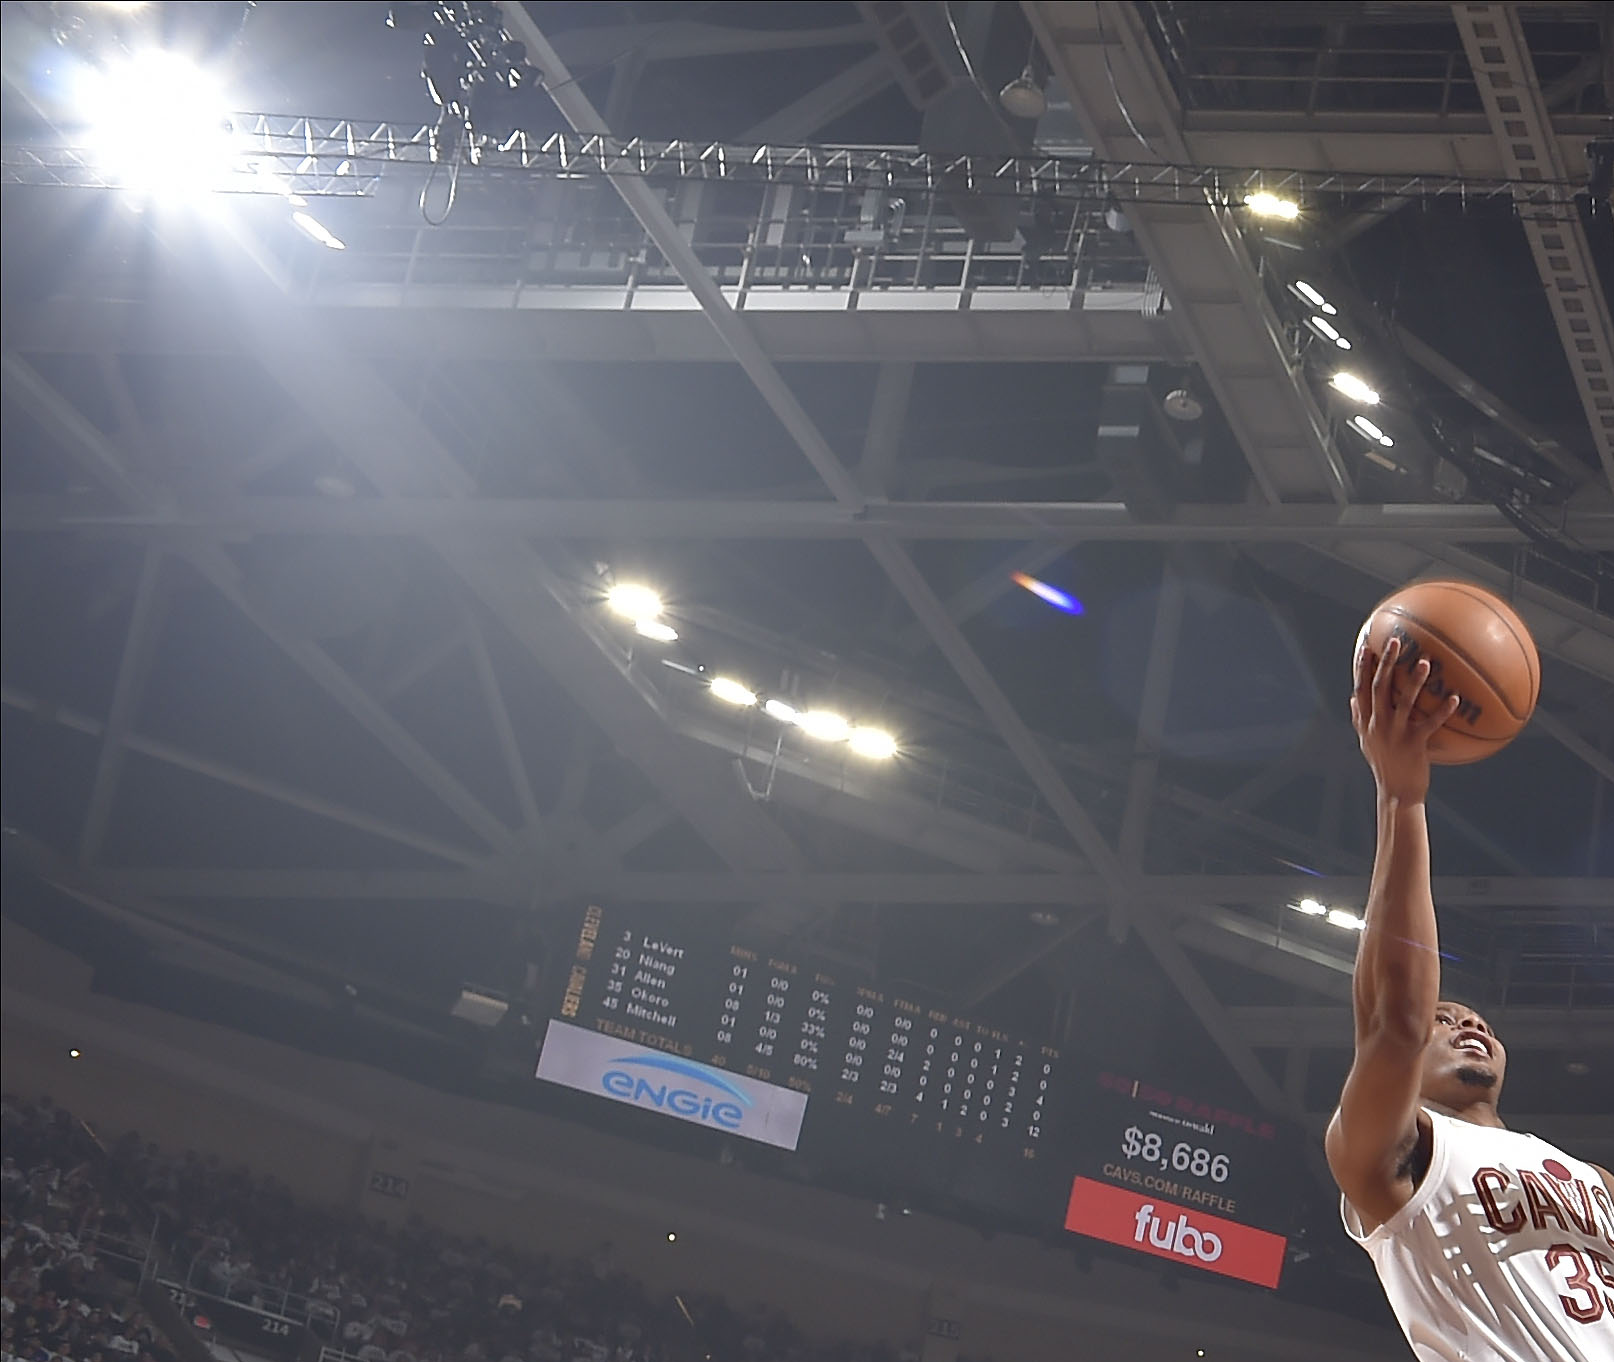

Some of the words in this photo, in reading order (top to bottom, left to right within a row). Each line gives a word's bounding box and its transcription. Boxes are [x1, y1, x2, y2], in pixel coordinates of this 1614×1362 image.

[644, 937, 683, 958] LeVert
[611, 964, 626, 976] 31
[634, 970, 666, 988] Allen
[615, 948, 630, 959] 20
[639, 954, 675, 976] Niang
[607, 981, 622, 993] 35
[631, 987, 669, 1007] Okoro
[603, 998, 618, 1009] 45
[627, 1004, 676, 1027] Mitchell
[1122, 1126, 1230, 1182] $8,686
[1134, 1204, 1222, 1262] fubo
